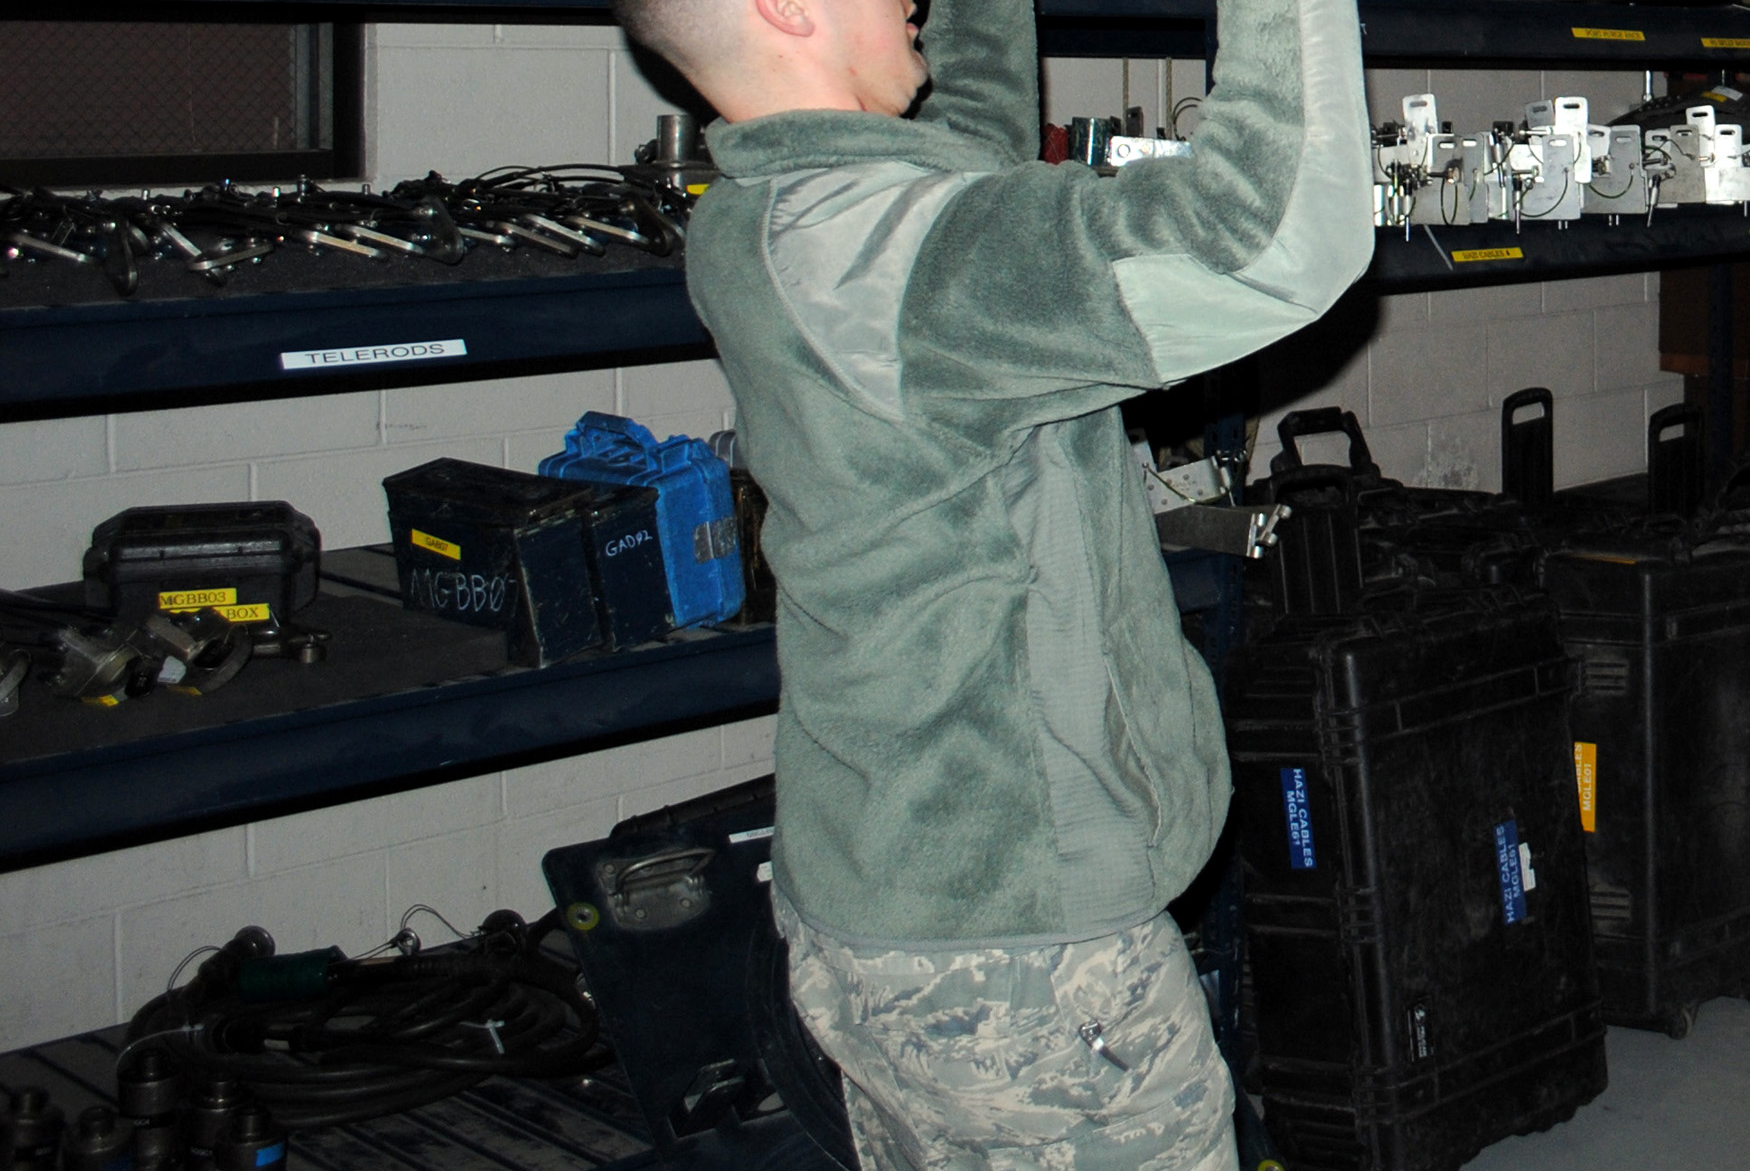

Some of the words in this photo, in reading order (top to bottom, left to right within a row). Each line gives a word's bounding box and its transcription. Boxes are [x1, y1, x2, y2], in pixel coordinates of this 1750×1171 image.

[305, 343, 445, 364] TELERODS
[160, 592, 226, 606] MGBB03
[226, 607, 259, 619] BOX
[1293, 768, 1305, 803] HAZI
[1299, 808, 1313, 867] CABLES
[1496, 826, 1510, 883] CABLES
[1504, 888, 1515, 923] HAZI
